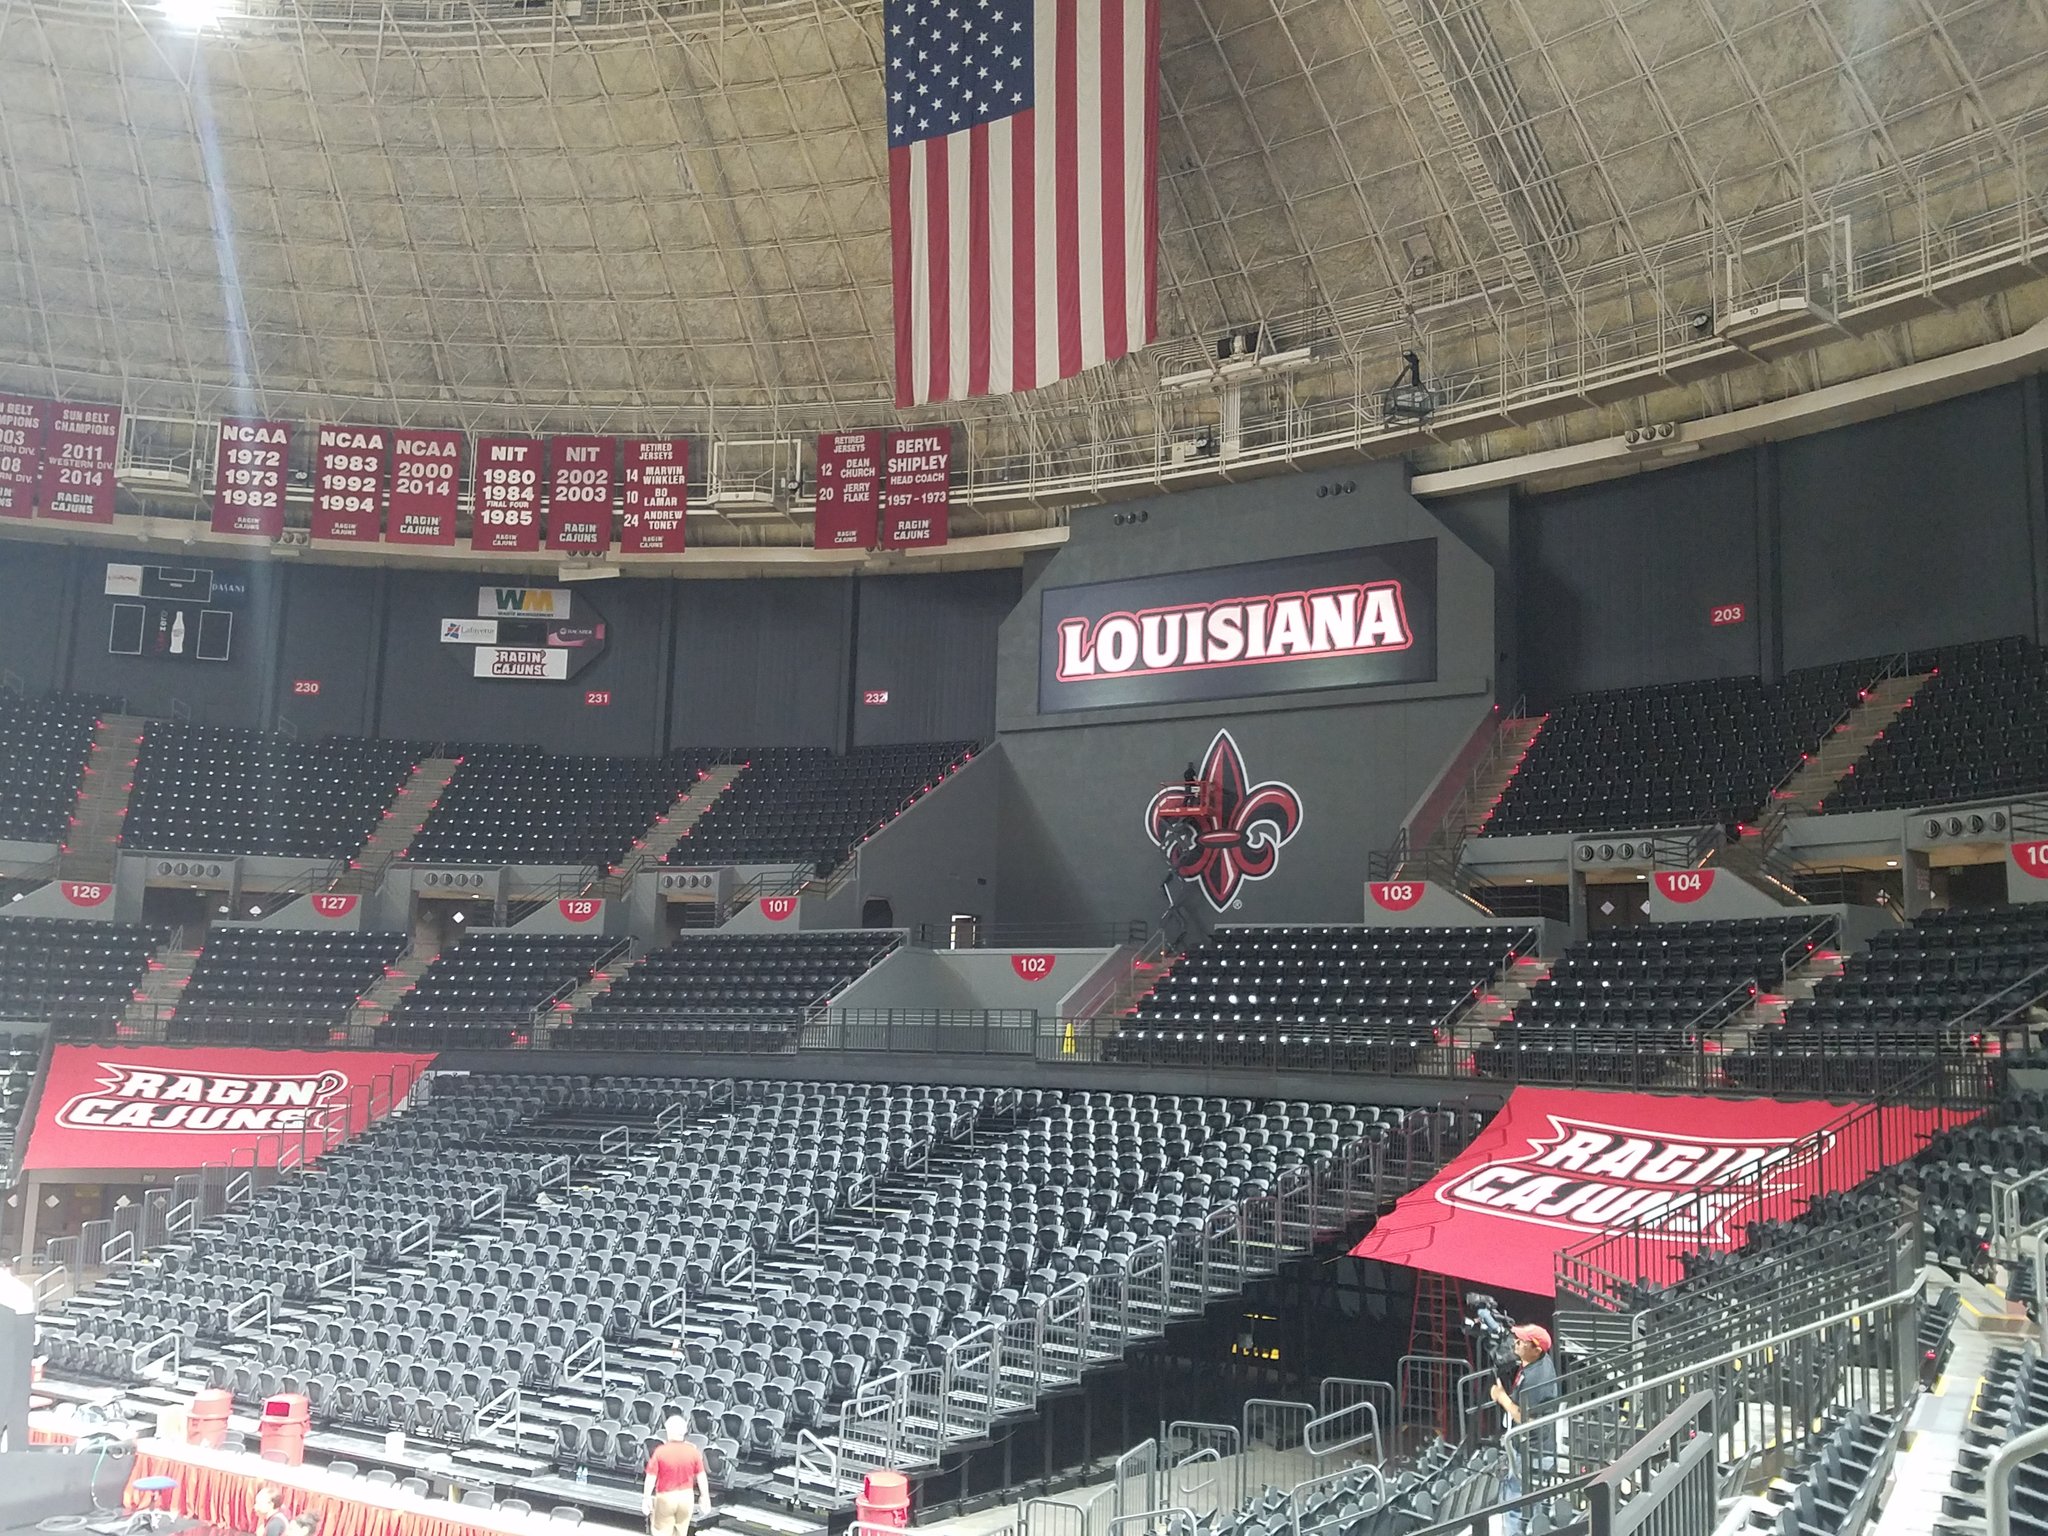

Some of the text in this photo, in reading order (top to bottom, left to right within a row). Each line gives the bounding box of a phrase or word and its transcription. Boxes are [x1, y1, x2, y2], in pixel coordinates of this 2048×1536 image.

[63, 410, 110, 423] SUN BELT
[55, 420, 116, 436] CHAMPIONS
[222, 425, 287, 445] NCAA
[0, 428, 24, 445] 03
[320, 431, 383, 450] NCAA
[834, 435, 865, 445] RETIRED
[62, 443, 103, 460] 2011
[396, 439, 457, 457] NCAA
[640, 443, 673, 452] RETIRED
[833, 444, 866, 454] JERSEYS
[896, 437, 941, 454] BERYL
[227, 449, 280, 467] 1972
[491, 446, 528, 462] NIT
[566, 446, 600, 462] NIT
[639, 452, 673, 460] JERSEYS
[1, 456, 21, 472] 08
[49, 457, 93, 468] WESTERN
[323, 454, 378, 472] 1983
[821, 463, 832, 476] 12
[846, 458, 870, 468] DEAN
[888, 454, 948, 473] SHIPLEY
[60, 468, 103, 486] 2014
[398, 461, 453, 479] 2000
[483, 468, 536, 485] 1980
[556, 469, 608, 485] 2002
[626, 469, 638, 482] 14
[645, 466, 683, 476] MARVIN
[840, 467, 875, 478] CHURCH
[225, 469, 278, 487] 1973
[322, 474, 376, 493] 1992
[643, 475, 685, 485] WINKLER
[890, 473, 945, 485] HEAD COACH
[395, 478, 450, 496] 2014
[482, 485, 535, 501] 1984
[555, 486, 606, 502] 2003
[655, 488, 668, 497] BO
[843, 482, 871, 493] JERRY
[222, 489, 278, 508] 1982
[626, 490, 638, 504] 10
[819, 488, 834, 501] 20
[843, 492, 870, 503] FLAKE
[887, 494, 912, 506] 1957
[921, 492, 946, 504] 1973
[51, 501, 94, 514] CAJUNS
[319, 495, 374, 513] 1994
[486, 500, 529, 509] FINAL FOUR
[644, 497, 678, 507] LAMAR
[480, 509, 533, 526] 1985
[623, 514, 639, 527] 24
[644, 510, 683, 520] ANDREW
[399, 524, 440, 536] CAJUNS
[648, 520, 678, 530] TONEY
[559, 533, 597, 543] CAJUNS
[893, 530, 930, 540] CAJUNS
[496, 589, 554, 612] WM
[1714, 607, 1741, 622] 203
[1059, 583, 1409, 679] LOUISIANA
[493, 663, 543, 675] CAJUNS
[295, 683, 318, 692] 230
[588, 694, 608, 703] 231
[1667, 873, 1701, 891] 104
[72, 885, 100, 899] 126
[1381, 886, 1412, 900] 103
[320, 897, 346, 910] 127
[567, 901, 591, 914] 128
[768, 900, 788, 913] 101
[1021, 958, 1045, 972] 102
[67, 1098, 318, 1129] CAJUNS
